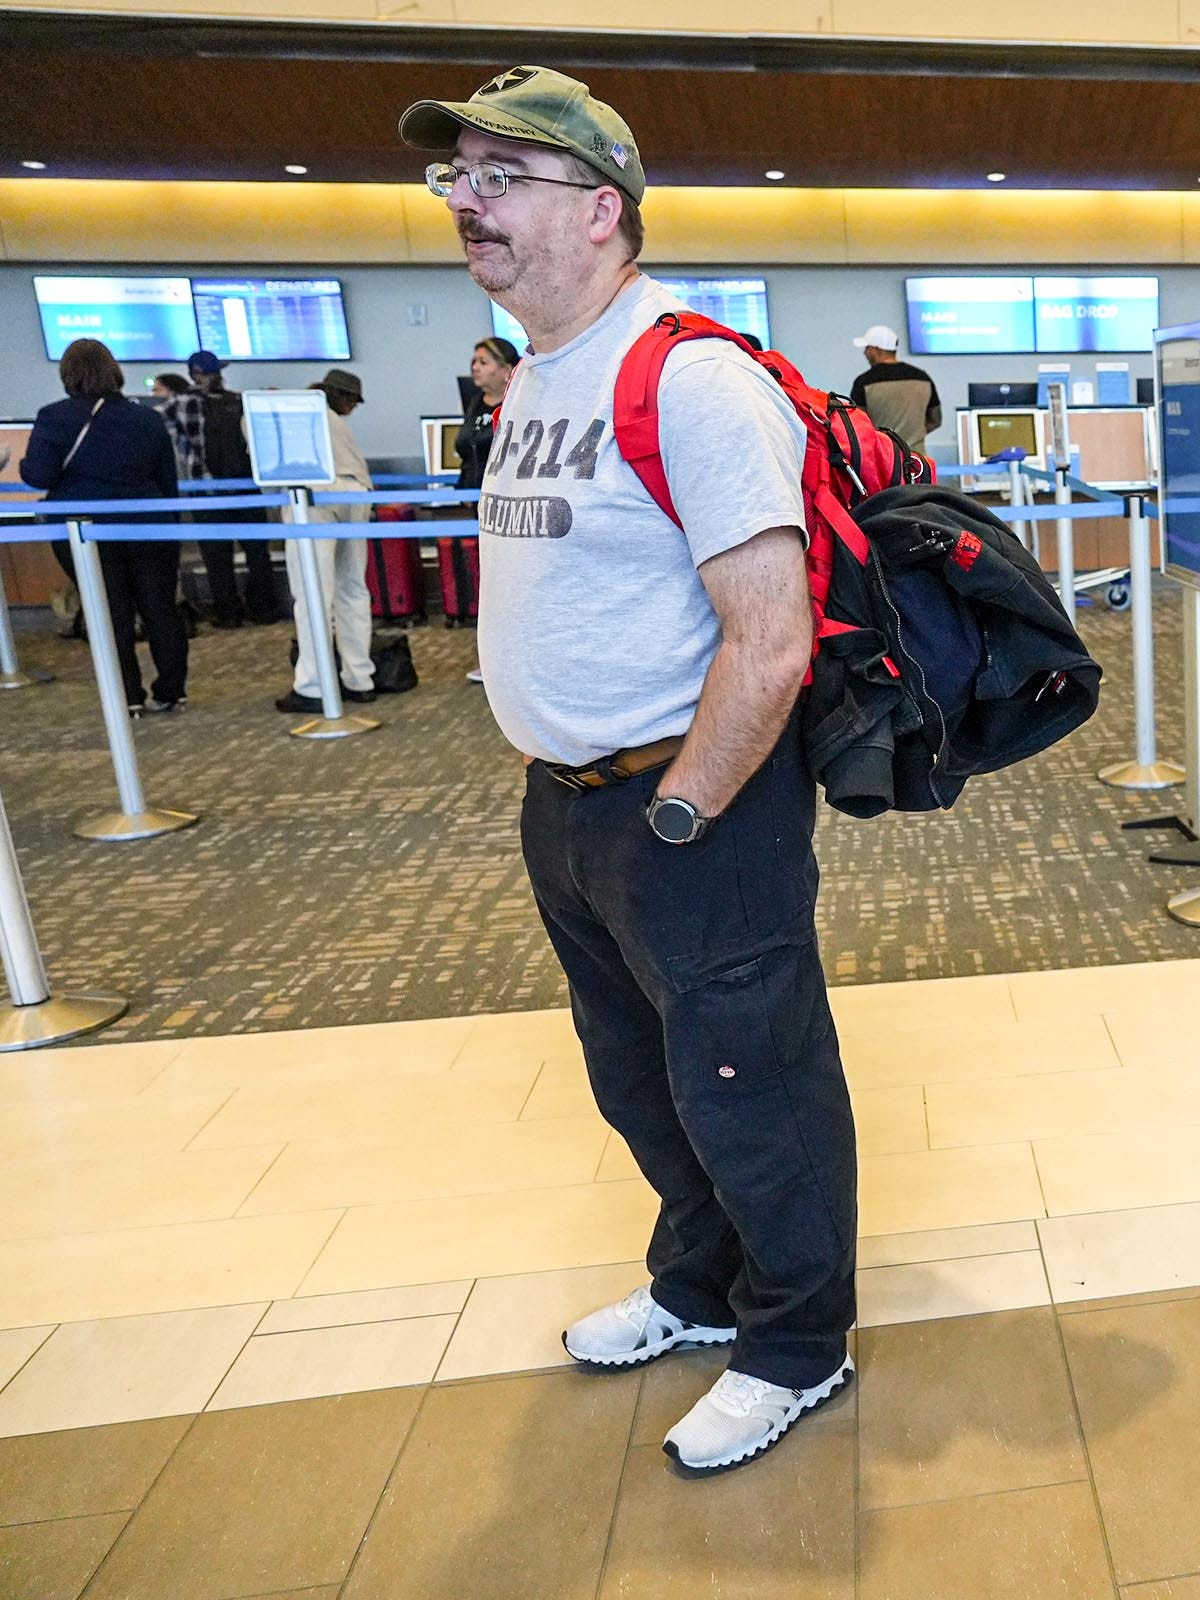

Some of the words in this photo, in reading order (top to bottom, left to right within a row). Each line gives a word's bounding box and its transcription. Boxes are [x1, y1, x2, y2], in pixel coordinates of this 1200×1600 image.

[475, 116, 536, 137] INFANTRY
[1040, 304, 1073, 319] BAG
[1076, 304, 1119, 319] DROP
[57, 313, 102, 327] MAIN
